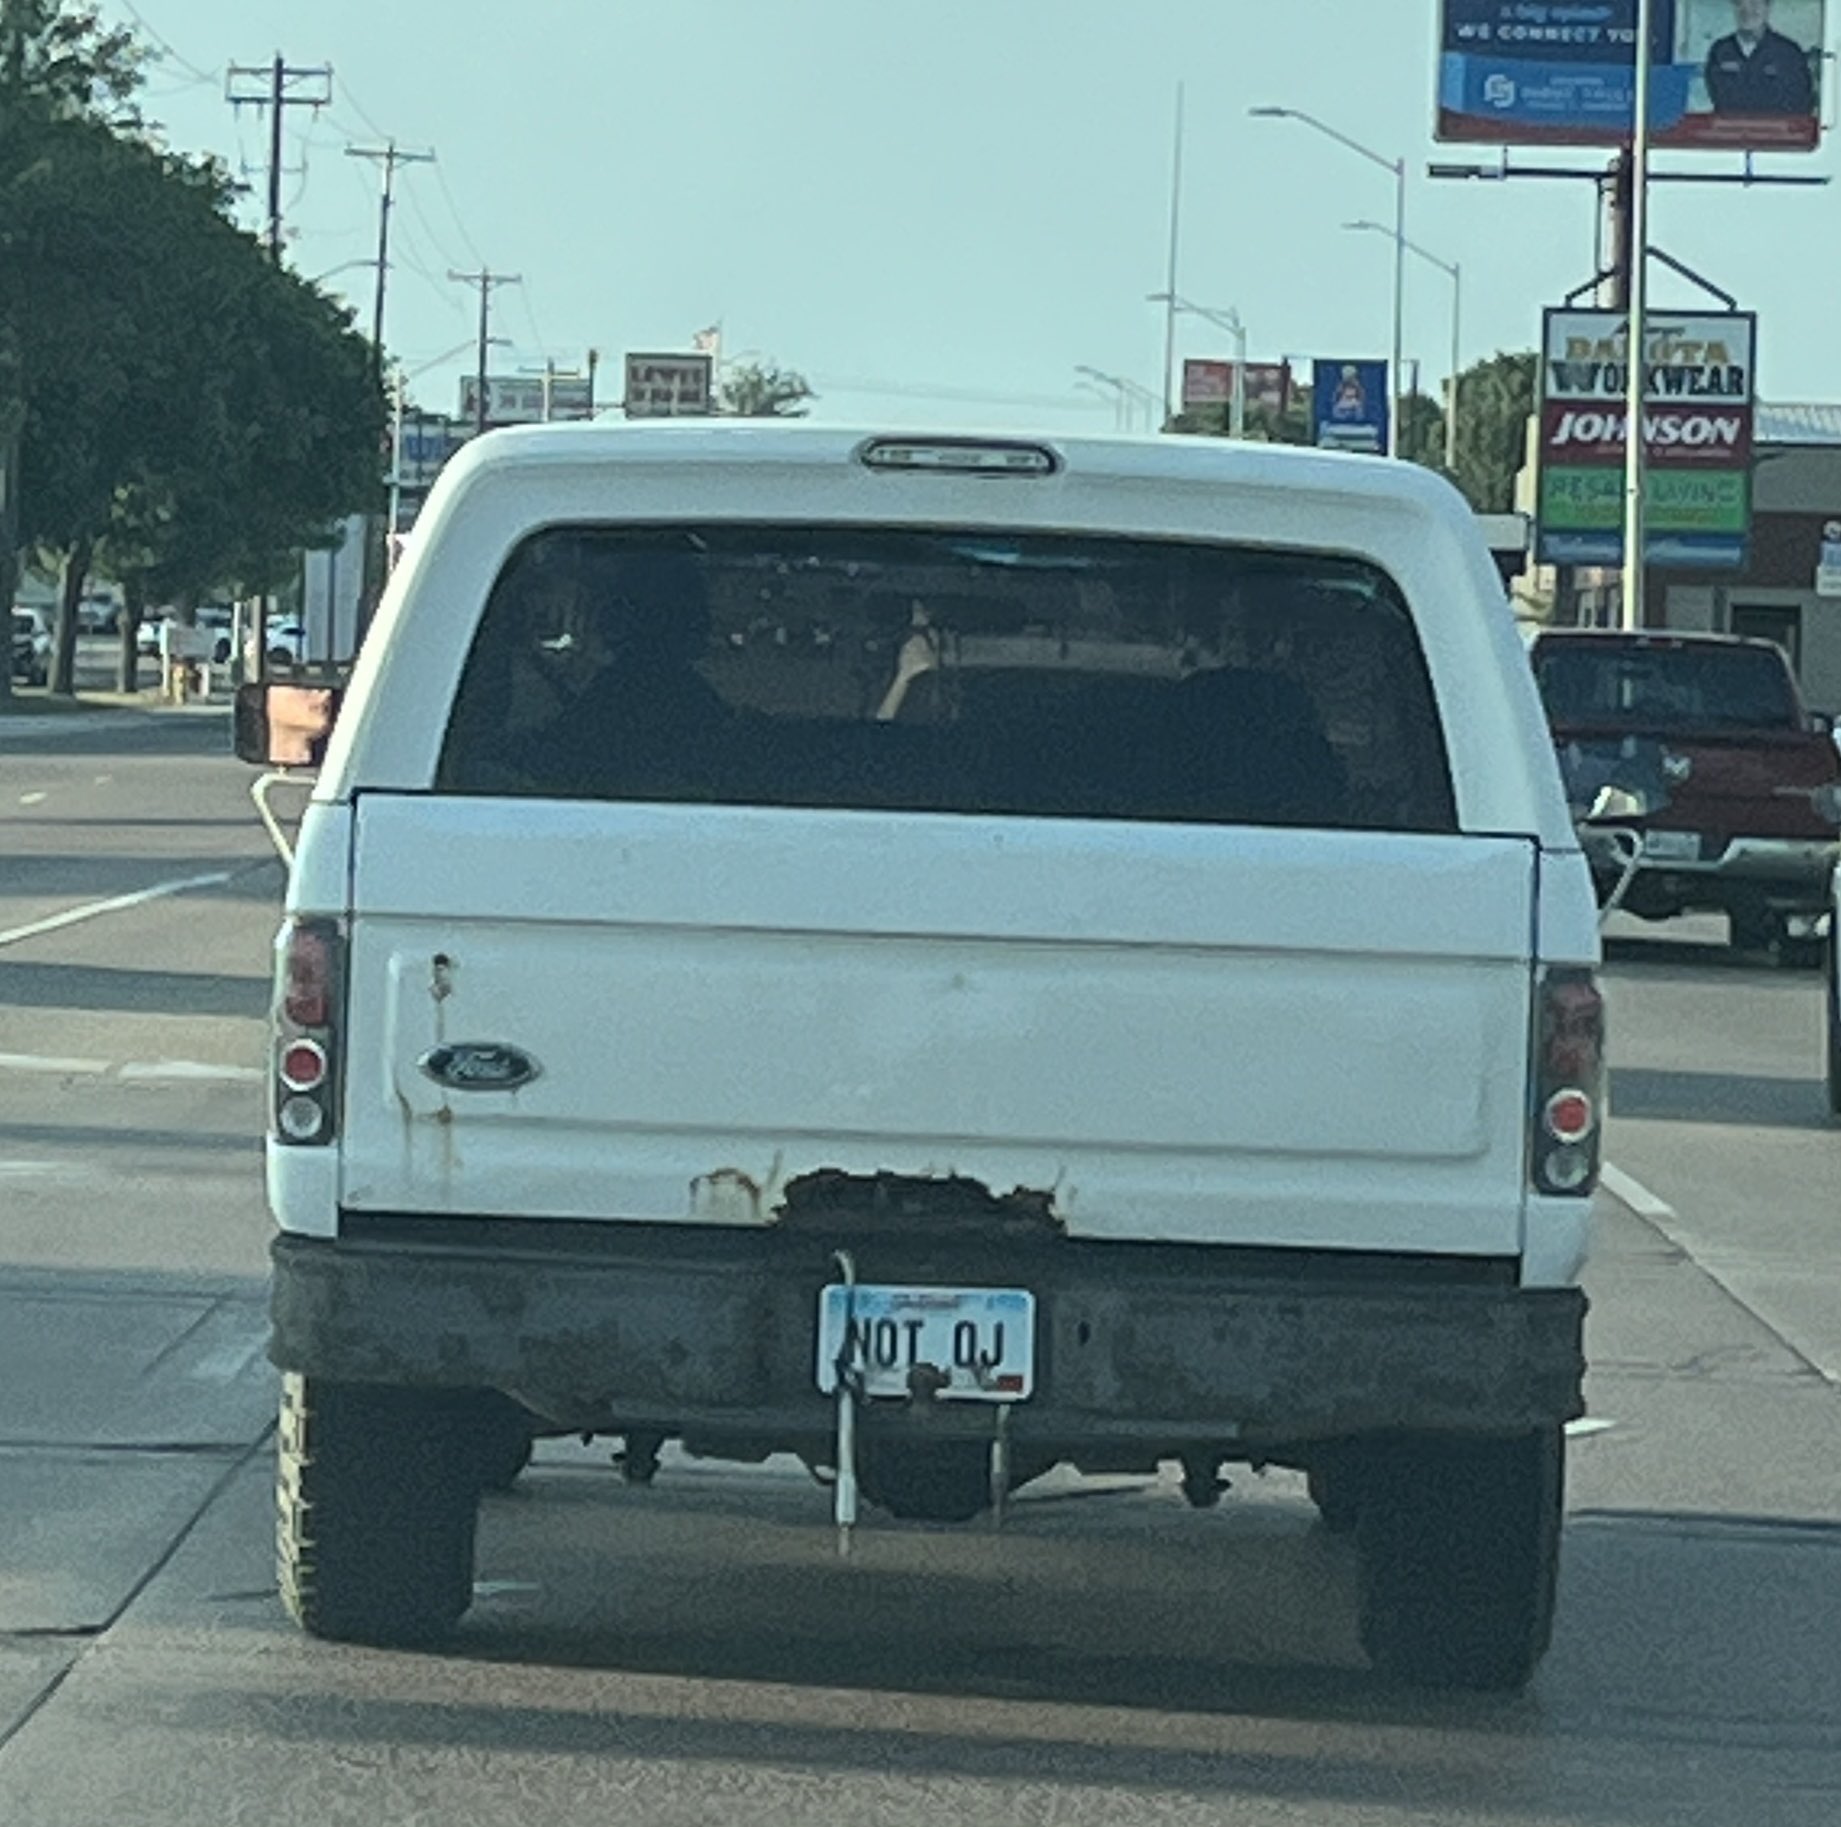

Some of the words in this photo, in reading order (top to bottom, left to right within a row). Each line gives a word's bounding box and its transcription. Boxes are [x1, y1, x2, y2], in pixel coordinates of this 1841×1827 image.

[1498, 25, 1600, 43] CONNECT
[1566, 337, 1728, 363] DAOTA
[848, 1317, 924, 1367] NOT
